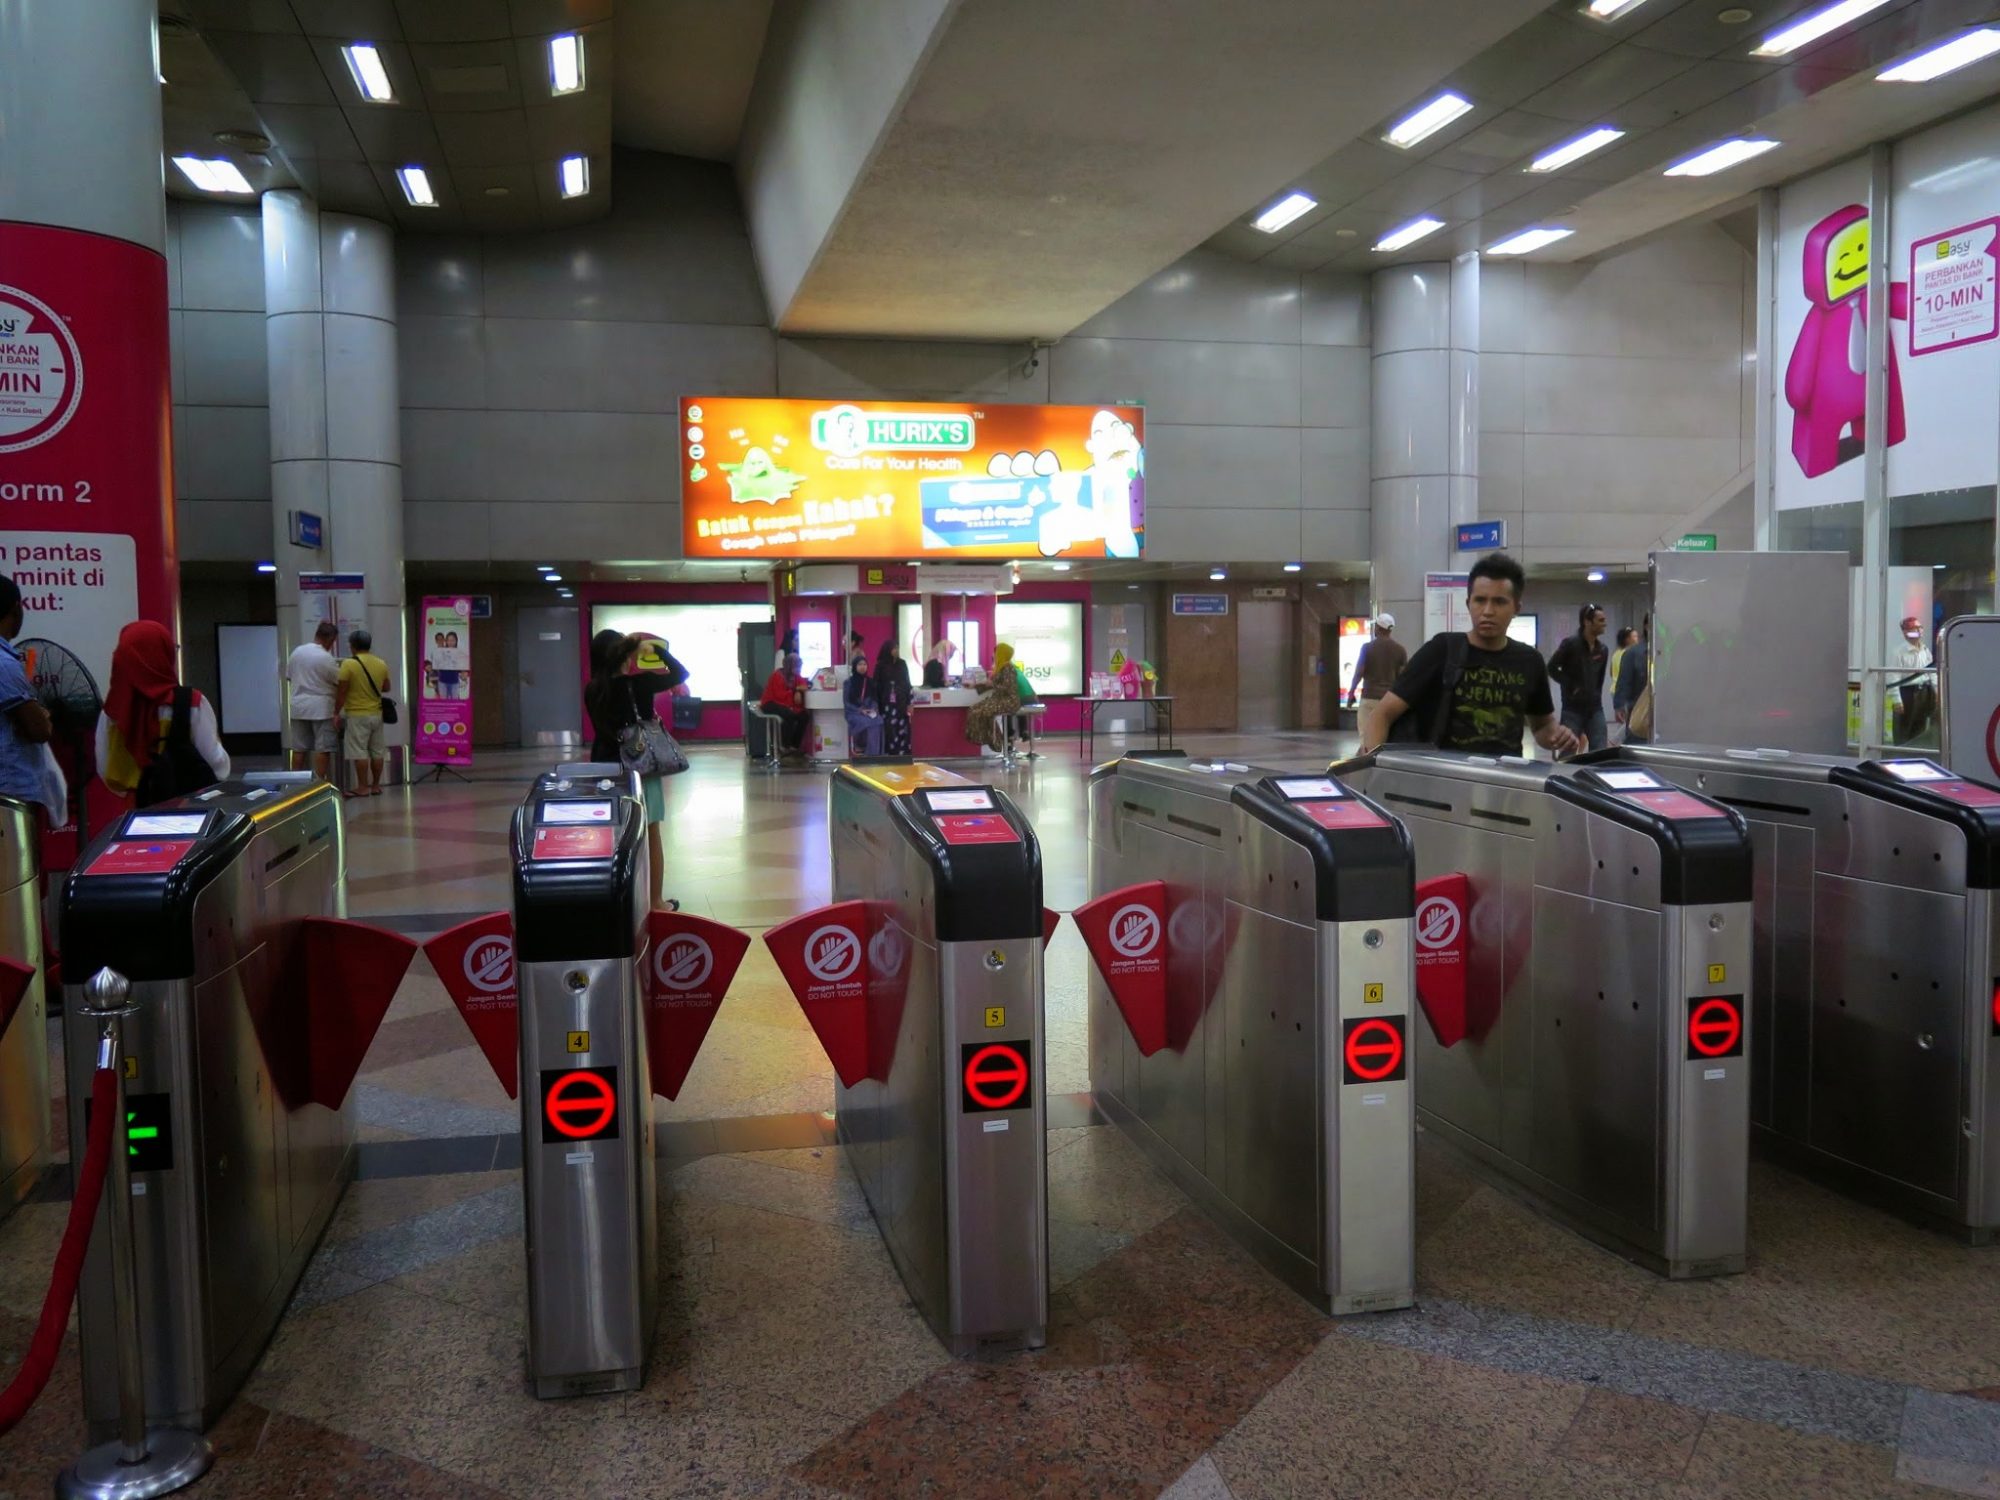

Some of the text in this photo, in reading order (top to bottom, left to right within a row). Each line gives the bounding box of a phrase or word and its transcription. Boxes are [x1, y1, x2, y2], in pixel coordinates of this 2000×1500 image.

[1925, 258, 1983, 282] PERBANKAN
[1925, 267, 1983, 290] PANTAS DI BANK
[1925, 283, 1983, 313] 10-MIN
[7, 355, 39, 365] BANK
[874, 421, 964, 444] HURIX'S
[826, 456, 962, 471] Care For Your Health
[75, 481, 91, 503] 2
[1677, 539, 1708, 547] Keluar
[16, 543, 102, 565] pantas
[12, 567, 104, 587] minit di
[1137, 965, 1160, 973] TOUCH
[1713, 967, 1720, 979] 7
[836, 982, 862, 990] Sentuh
[655, 993, 683, 1001] Jangan
[820, 991, 835, 999] NOT
[837, 989, 862, 998] TOUCH
[1370, 986, 1377, 999] 6
[466, 995, 495, 1003] Jangan
[655, 1000, 712, 1009] DO NOT TOUCH
[480, 1002, 496, 1010] NOT
[991, 1011, 999, 1023] 5
[573, 1035, 583, 1048] 4
